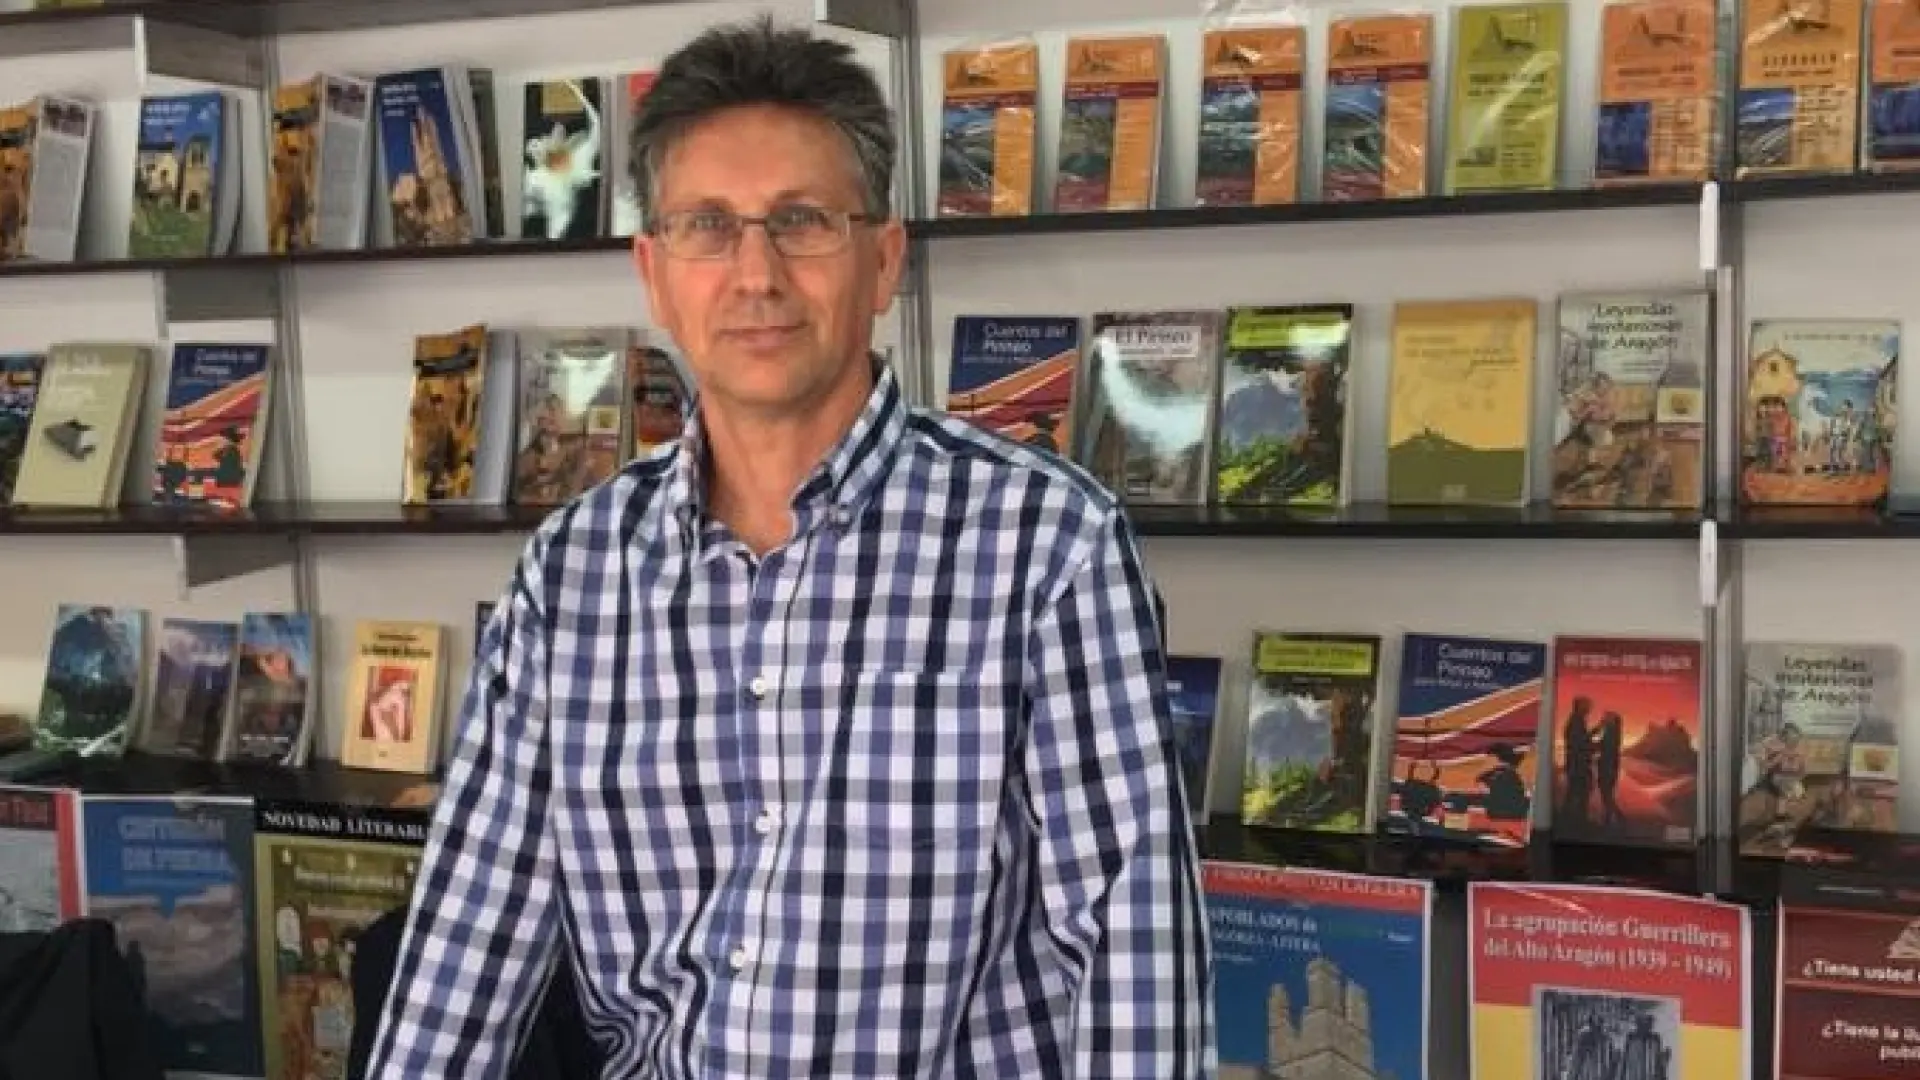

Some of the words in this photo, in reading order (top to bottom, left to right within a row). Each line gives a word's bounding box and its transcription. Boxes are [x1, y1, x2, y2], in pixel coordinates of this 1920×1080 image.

[1438, 643, 1505, 663] Cuentos
[264, 810, 341, 832] NOVEDAD
[1483, 907, 1508, 929] La
[1512, 909, 1618, 937] agrupación
[1622, 915, 1731, 949] Guerrillera
[1484, 937, 1507, 956] del
[1511, 939, 1549, 960] Alto
[1553, 944, 1615, 968] Aragón
[1802, 957, 1860, 977] ¿Tiene
[1864, 966, 1915, 981] usted
[1821, 1019, 1879, 1039] ¿Tiene
